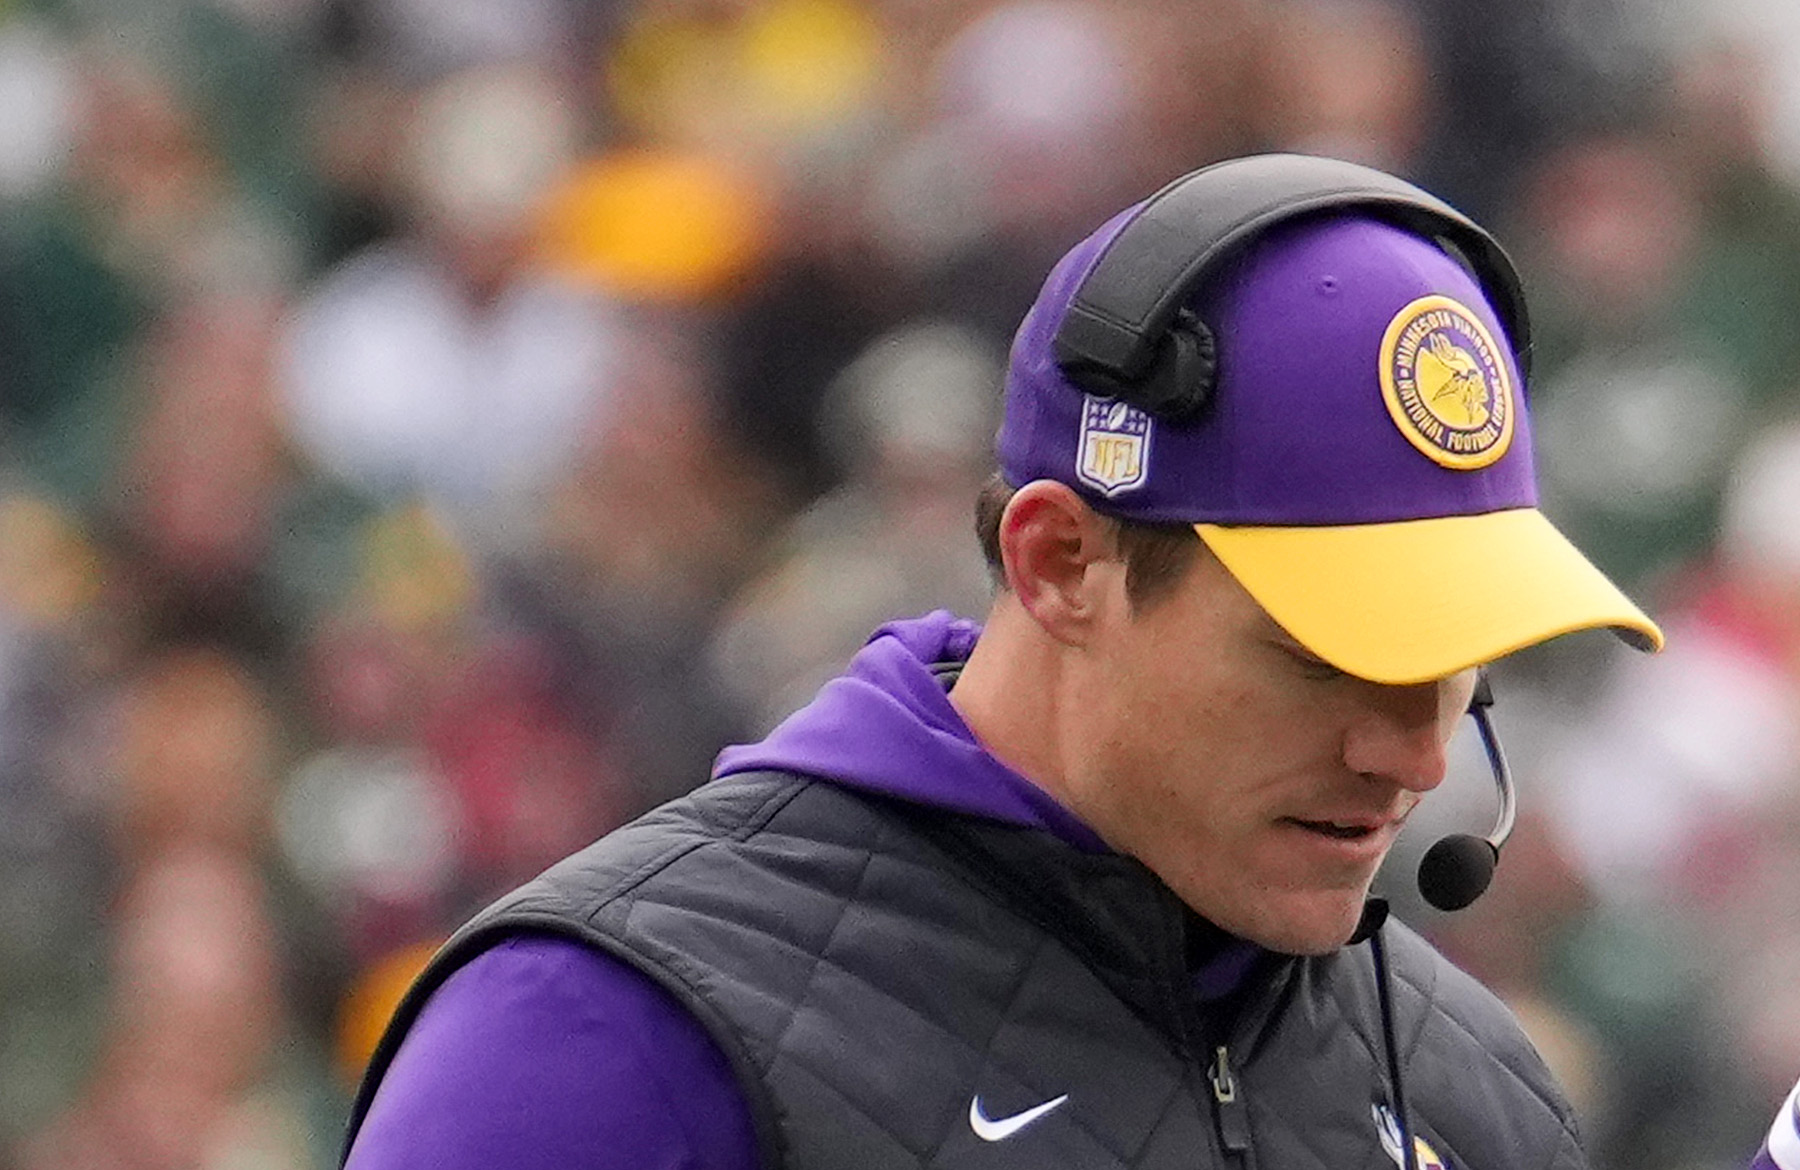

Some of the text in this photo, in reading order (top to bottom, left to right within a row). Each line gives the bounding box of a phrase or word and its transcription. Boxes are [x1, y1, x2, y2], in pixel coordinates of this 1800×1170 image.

[1396, 310, 1452, 369] MINNESOTA
[1396, 379, 1445, 444] NATIONAL
[1088, 436, 1139, 479] NFL
